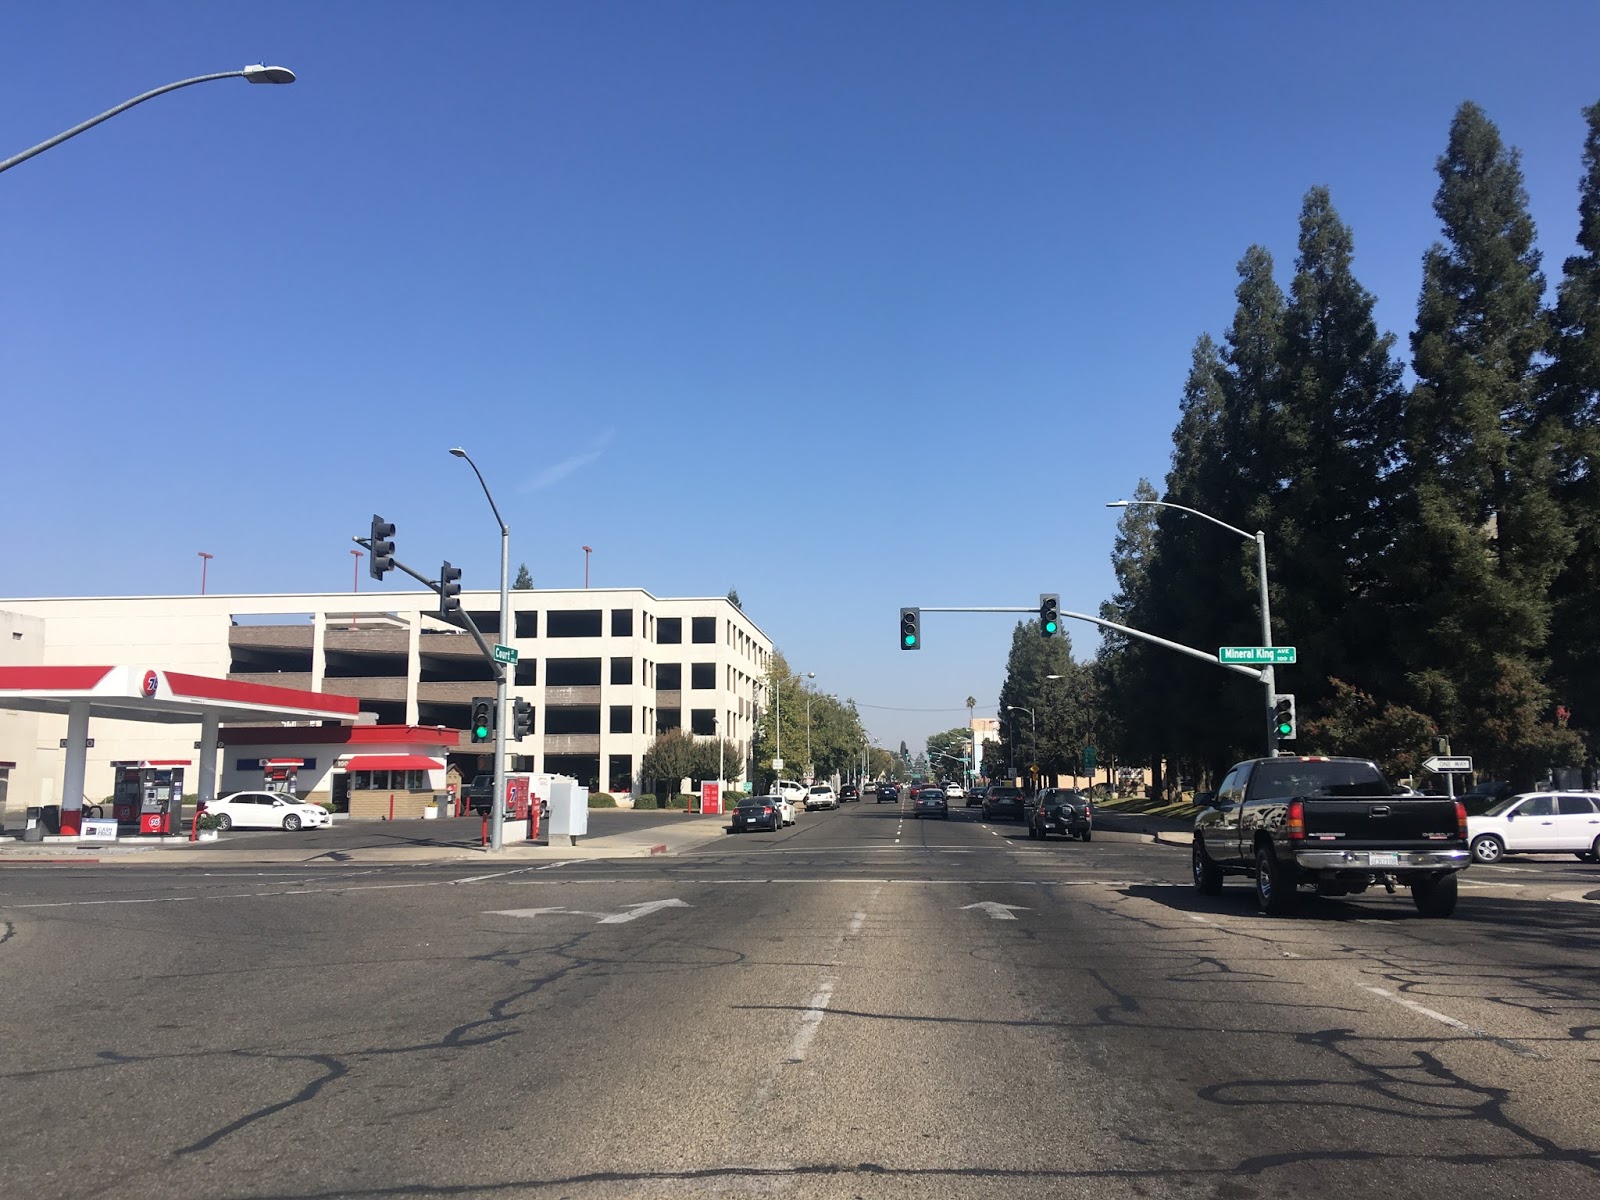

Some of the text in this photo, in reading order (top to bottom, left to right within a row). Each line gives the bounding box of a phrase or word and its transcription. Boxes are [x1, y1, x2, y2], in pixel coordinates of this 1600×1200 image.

[495, 647, 511, 661] Court
[1225, 648, 1254, 659] Mineral
[1256, 648, 1275, 662] King
[150, 818, 161, 827] 76
